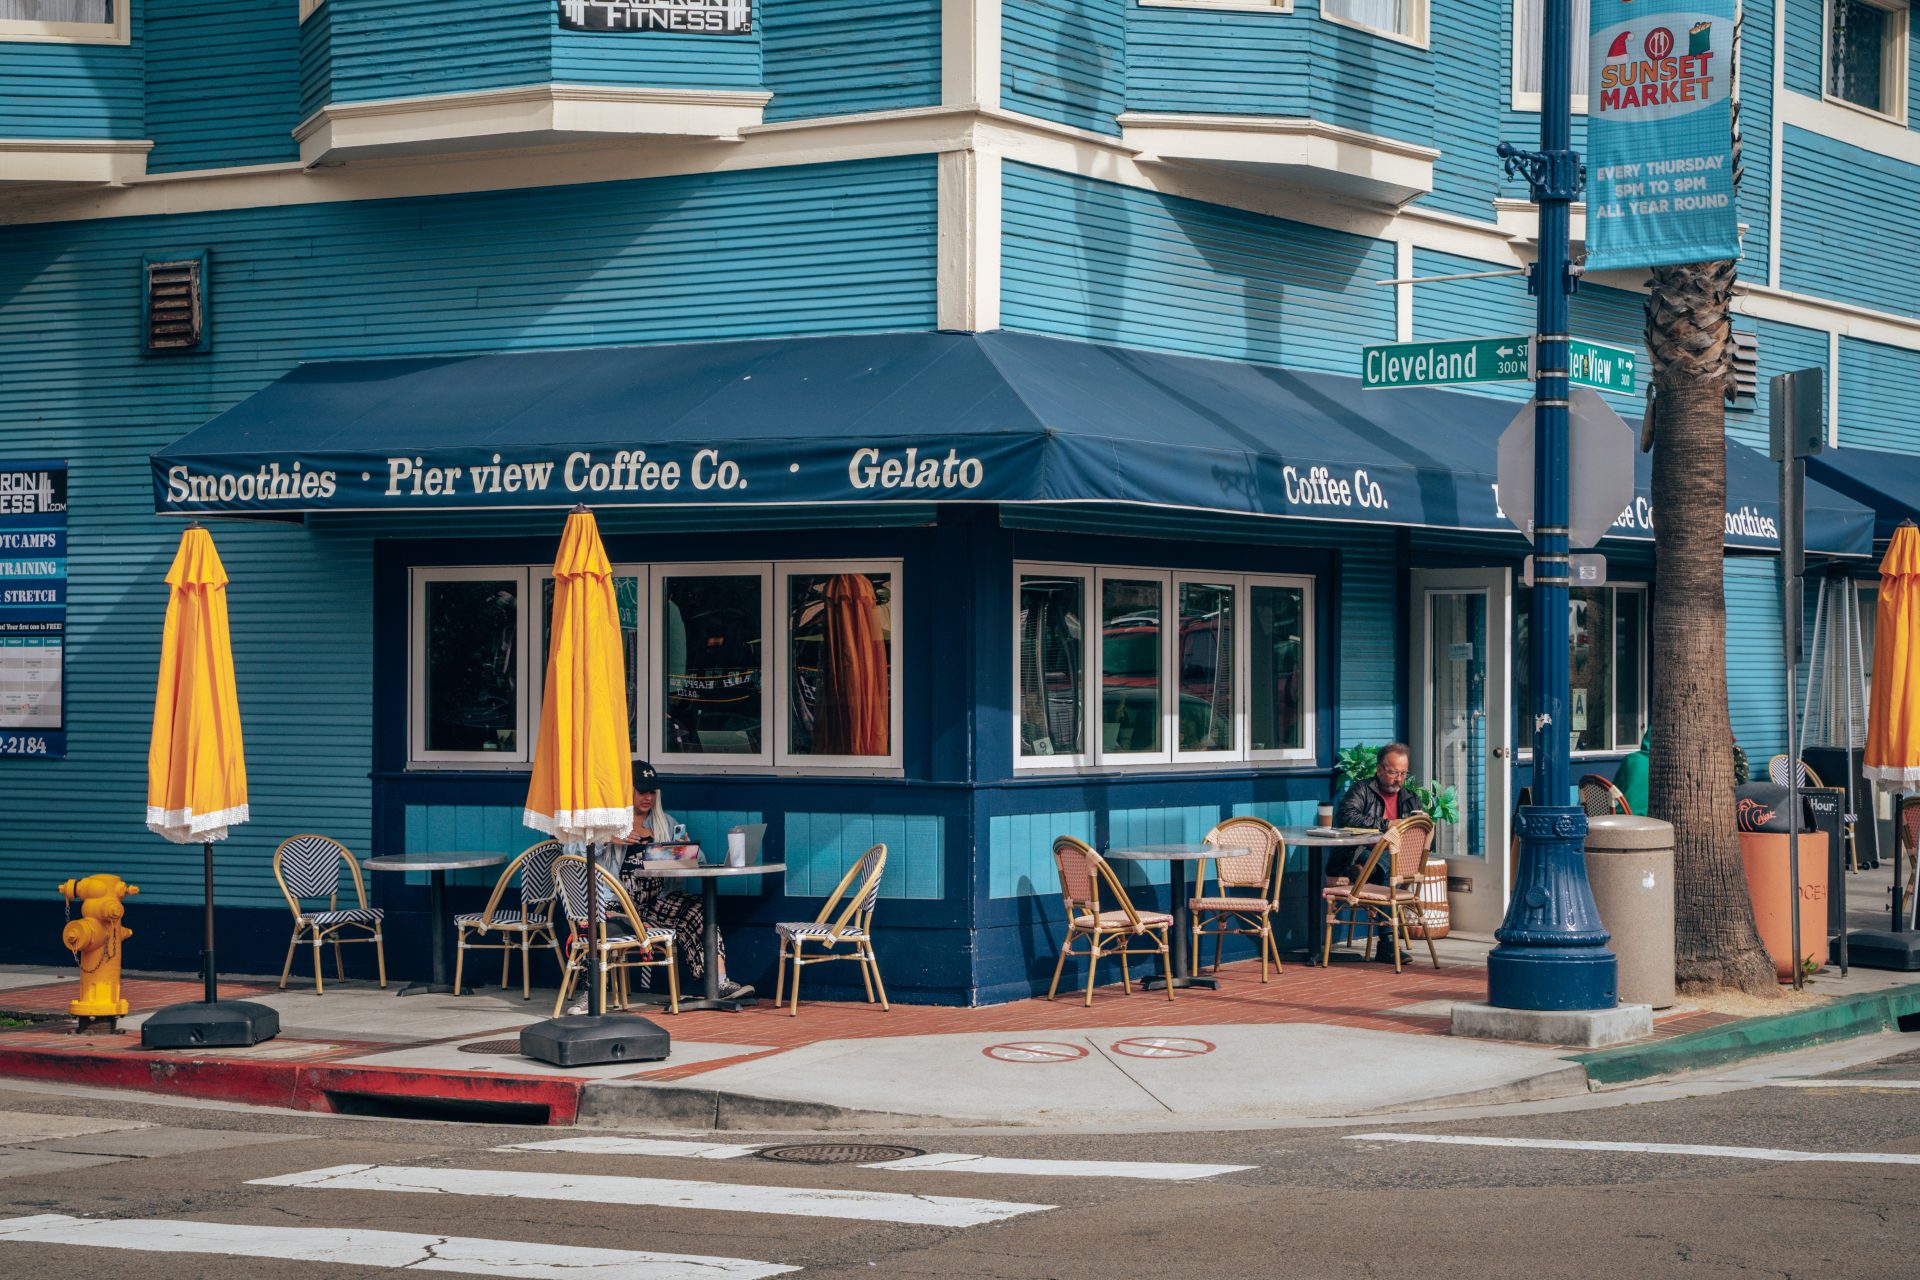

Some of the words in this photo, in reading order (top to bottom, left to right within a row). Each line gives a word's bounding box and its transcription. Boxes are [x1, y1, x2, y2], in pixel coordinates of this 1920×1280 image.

[607, 6, 723, 31] FITNESS
[1601, 52, 1713, 89] SUNSET
[1600, 77, 1713, 112] MARKET
[1597, 163, 1642, 181] EVERY
[1646, 155, 1724, 176] THURSDAY
[1615, 182, 1644, 198] 5PM
[1649, 180, 1669, 195] TO
[1674, 176, 1707, 193] 9PM
[1596, 204, 1625, 219] ALL
[1629, 199, 1669, 216] YEAR
[1674, 194, 1729, 212] ROUND
[1517, 344, 1528, 357] ST
[1366, 345, 1477, 384] Cleveland
[1497, 361, 1518, 374] 300
[1521, 361, 1527, 373] N
[1588, 348, 1611, 385] View
[166, 461, 337, 504] Smoothies
[384, 456, 461, 497] Pier
[469, 453, 554, 494] view
[563, 450, 681, 493] Coffee
[691, 448, 748, 491] Co.
[848, 447, 984, 490] Gelato
[1283, 465, 1352, 507] Coffee
[1354, 469, 1389, 510] Co.
[47, 503, 67, 512] .COM
[1725, 506, 1778, 539] oothies
[0, 561, 57, 576] TRAINING
[4, 589, 57, 603] STRETCH
[6, 623, 18, 631] Your
[1576, 694, 1584, 714] A
[1810, 798, 1835, 812] Hour
